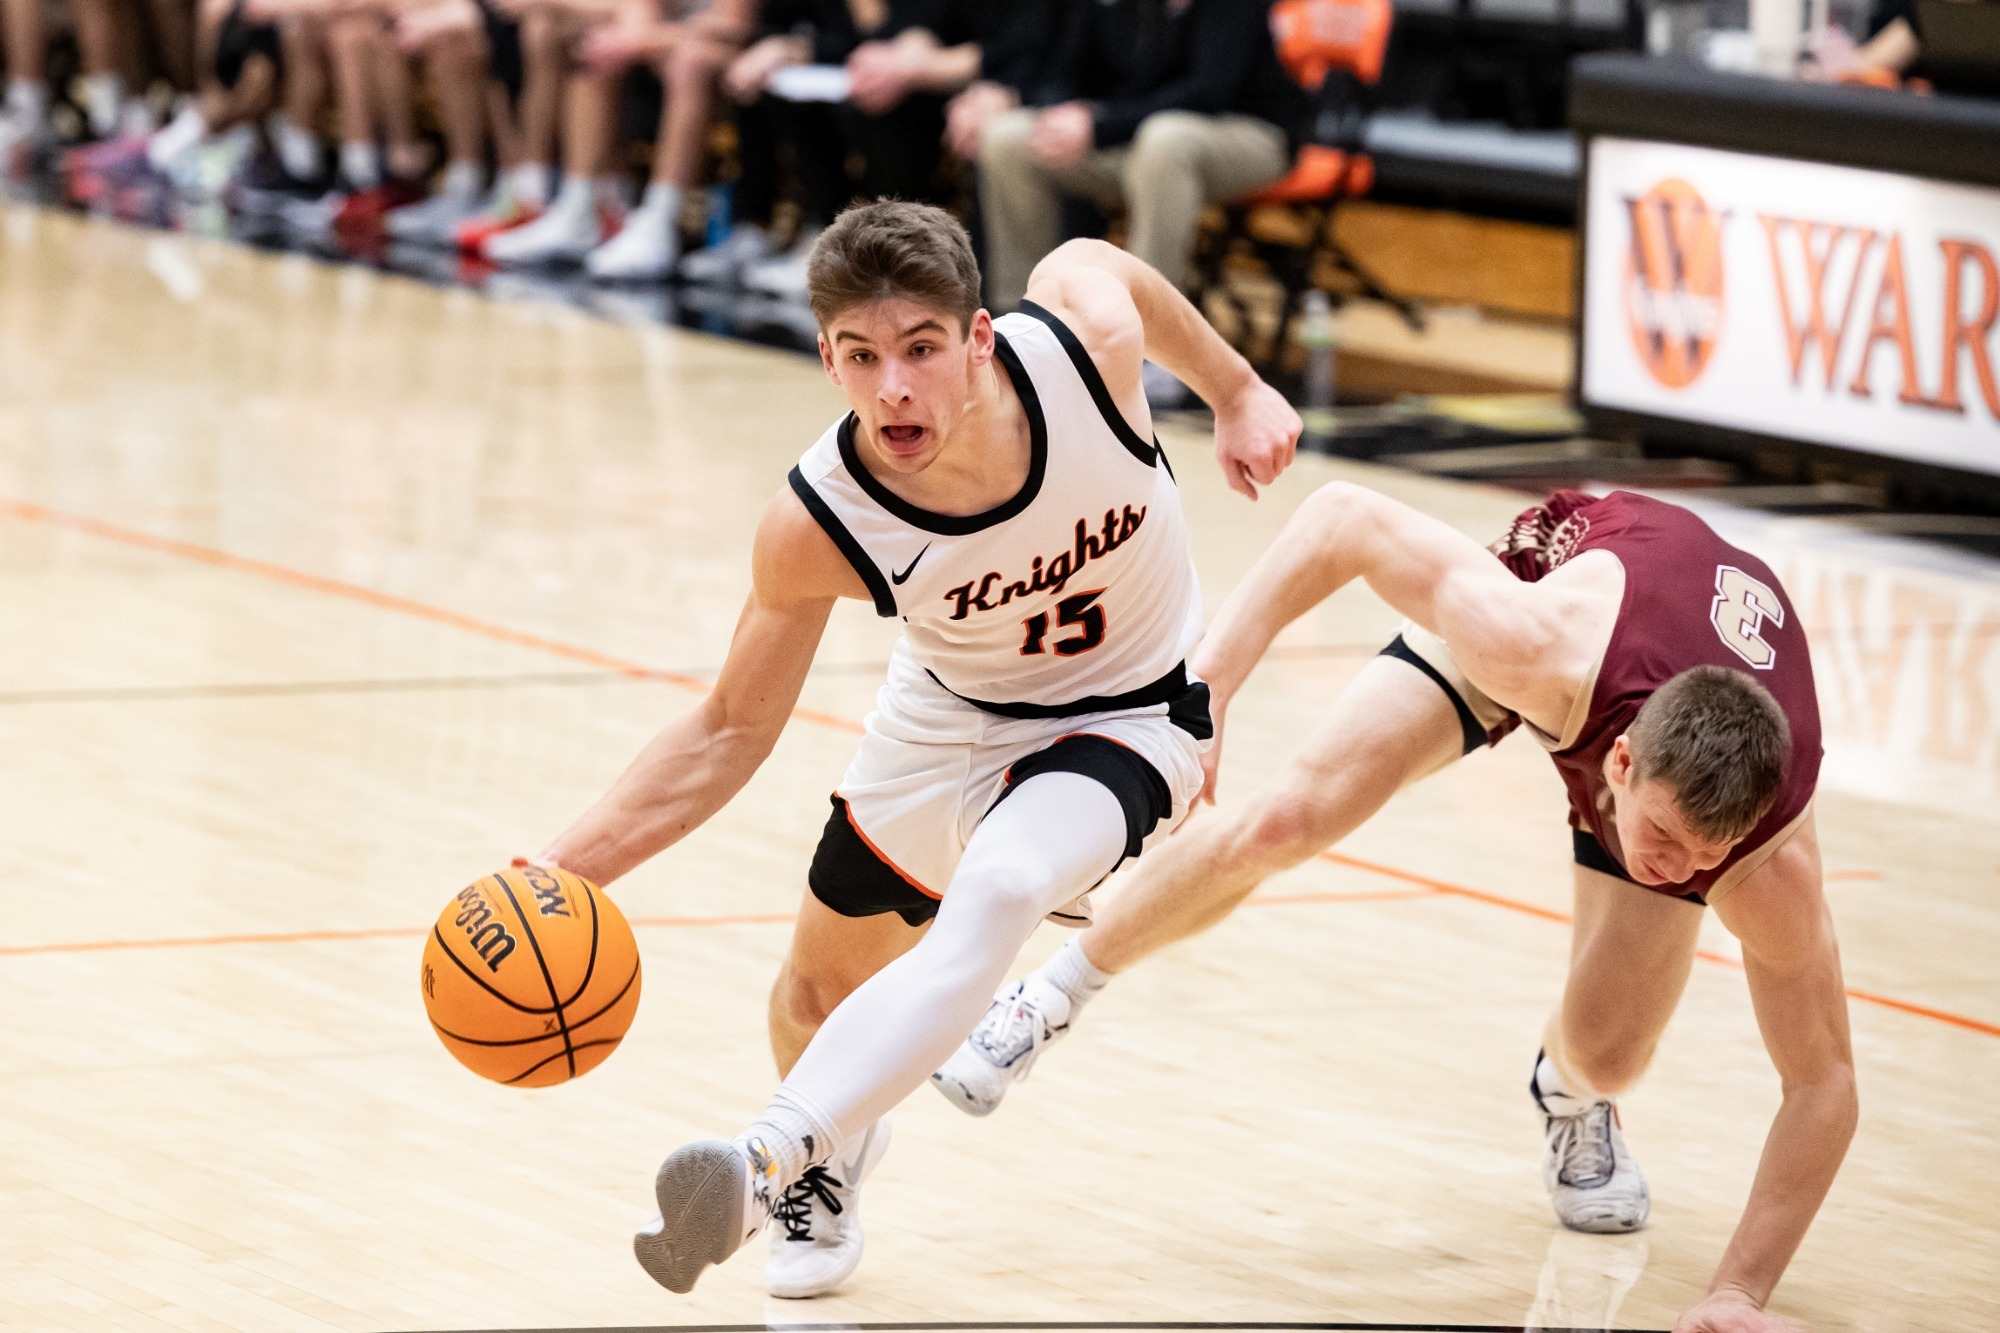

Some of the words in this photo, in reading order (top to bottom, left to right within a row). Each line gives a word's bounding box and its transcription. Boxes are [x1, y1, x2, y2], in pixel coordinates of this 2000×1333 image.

[1757, 212, 2000, 422] WAR
[943, 503, 1147, 620] Knights
[1019, 586, 1108, 657] 15
[1710, 565, 1785, 669] 3
